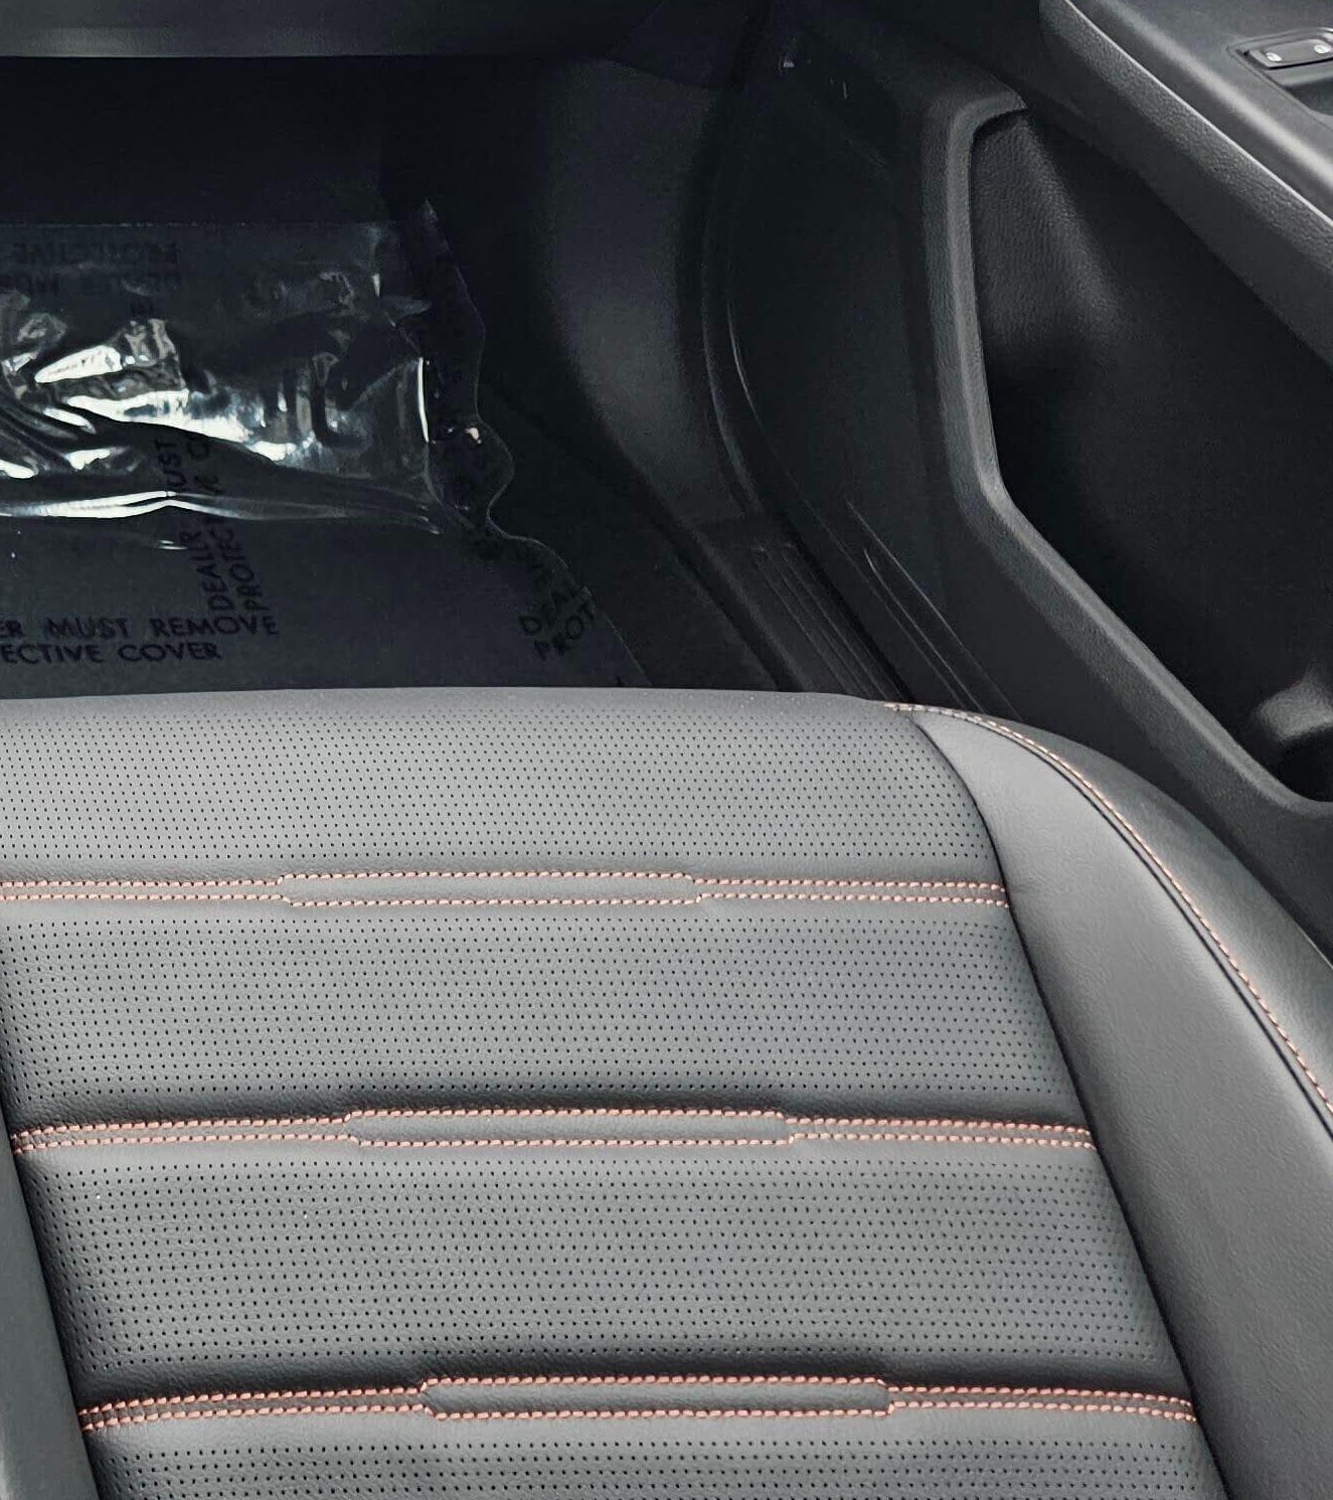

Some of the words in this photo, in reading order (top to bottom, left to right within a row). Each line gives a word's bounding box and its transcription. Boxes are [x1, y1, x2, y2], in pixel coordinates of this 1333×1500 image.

[44, 616, 132, 640] MUST
[148, 615, 280, 639] REMOVE
[117, 641, 222, 663] COVER
